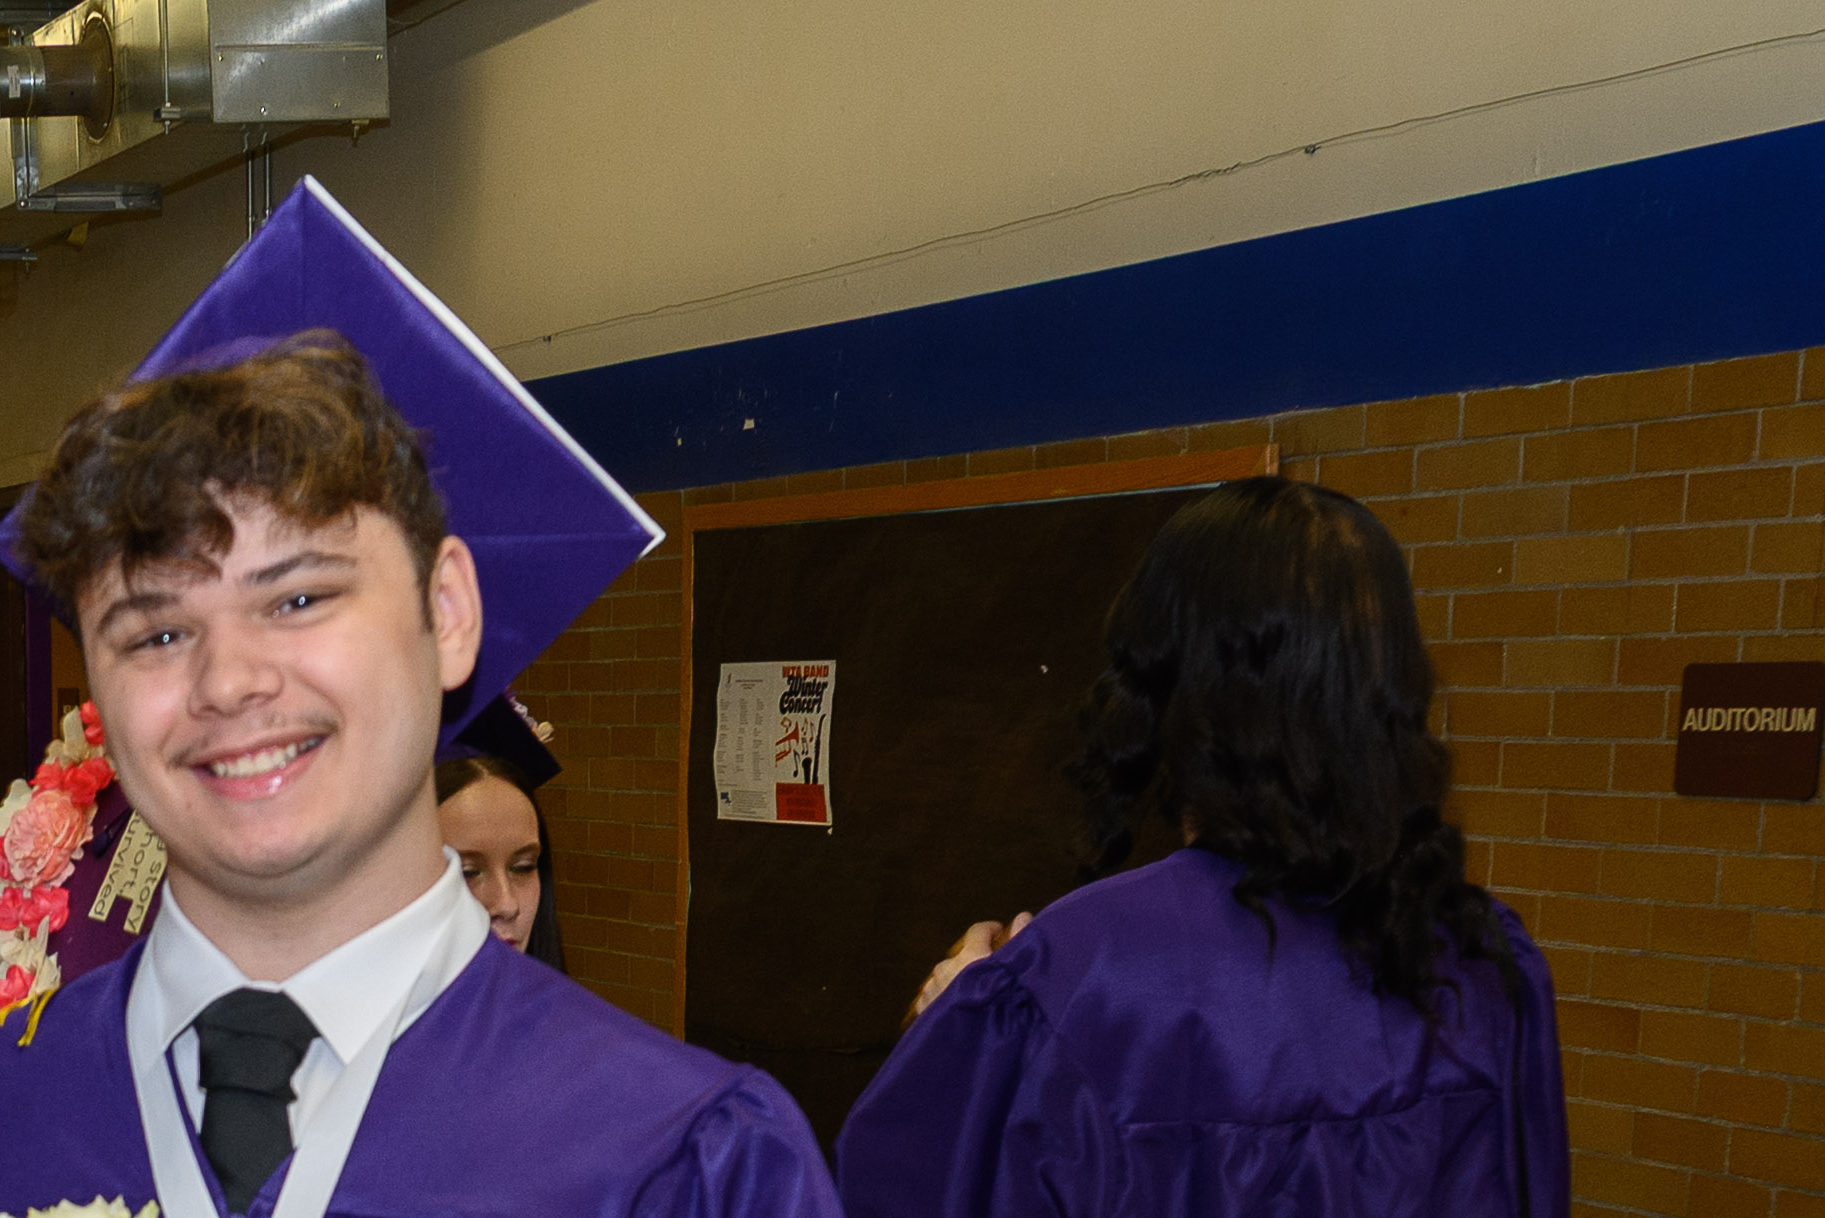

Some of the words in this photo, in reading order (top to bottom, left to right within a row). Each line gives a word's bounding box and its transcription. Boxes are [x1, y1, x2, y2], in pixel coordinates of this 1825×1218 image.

[804, 664, 829, 678] BAND
[786, 674, 829, 697] Winter
[779, 689, 823, 715] Concert
[1681, 707, 1817, 732] AUDITORIUM
[93, 814, 140, 917] urvived
